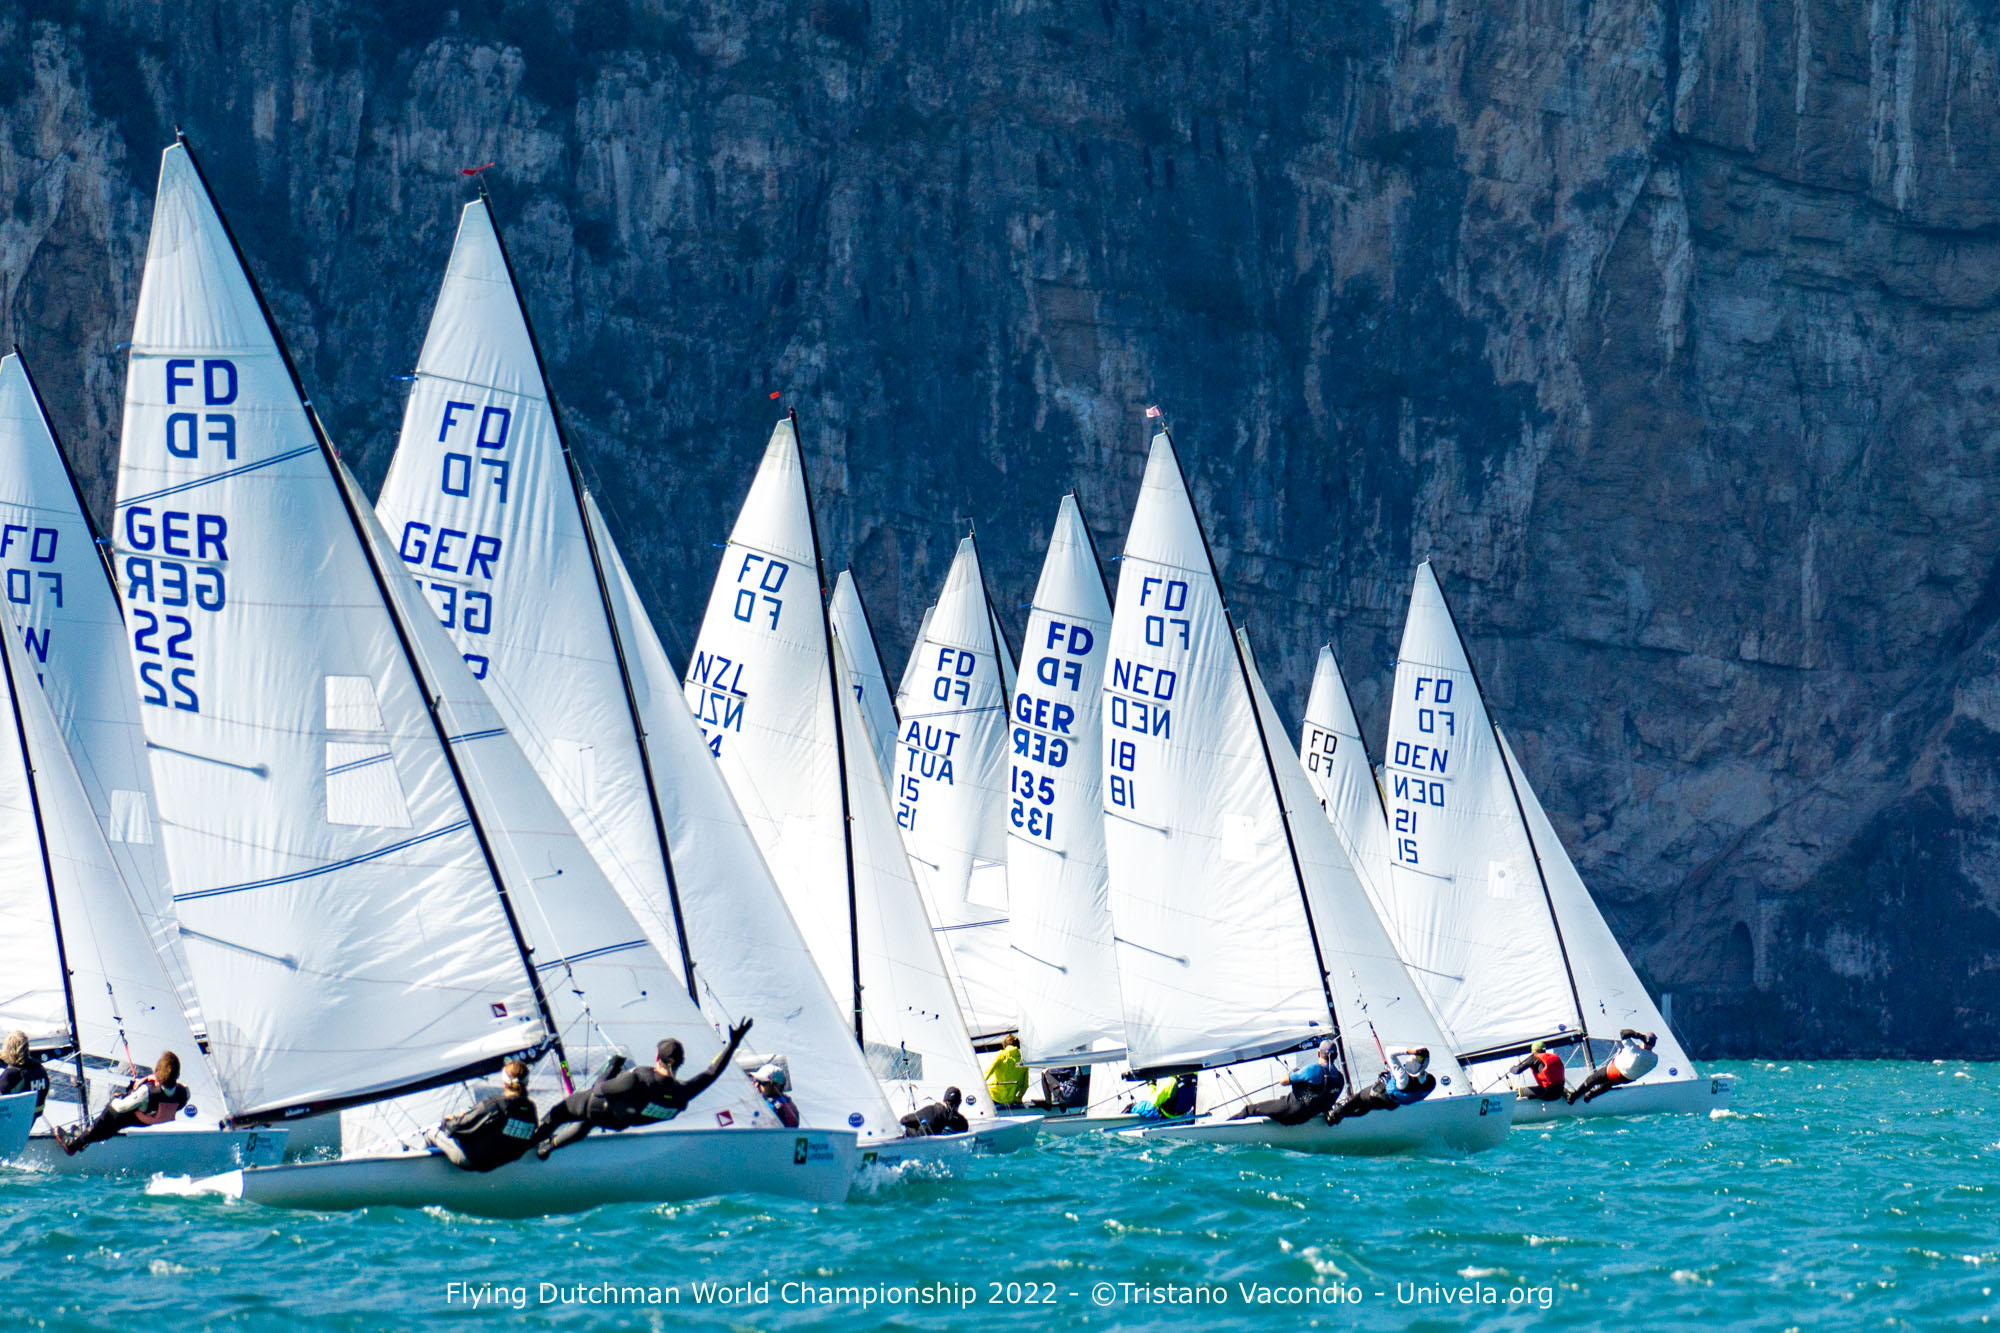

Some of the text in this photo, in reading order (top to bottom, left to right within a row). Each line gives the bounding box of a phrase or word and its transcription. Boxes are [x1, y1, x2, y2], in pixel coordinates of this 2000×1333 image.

[166, 359, 239, 406] FD
[438, 400, 511, 450] FD
[0, 524, 59, 563] FD
[126, 506, 229, 561] GER
[399, 521, 502, 580] GER
[737, 554, 789, 593] FD
[1140, 577, 1188, 611] FD
[133, 608, 194, 661] 22
[1046, 621, 1094, 656] FD
[693, 651, 748, 697] NZL
[937, 647, 975, 677] FD
[1113, 658, 1176, 700] NED
[1415, 677, 1453, 703] FD
[1016, 693, 1075, 734] GER
[905, 721, 961, 756] AUT
[1111, 738, 1136, 772] 18
[1311, 729, 1337, 755] FD
[1394, 741, 1449, 773] DEN
[900, 774, 920, 802] 15
[1011, 765, 1055, 805] 135
[1395, 808, 1417, 834] 21
